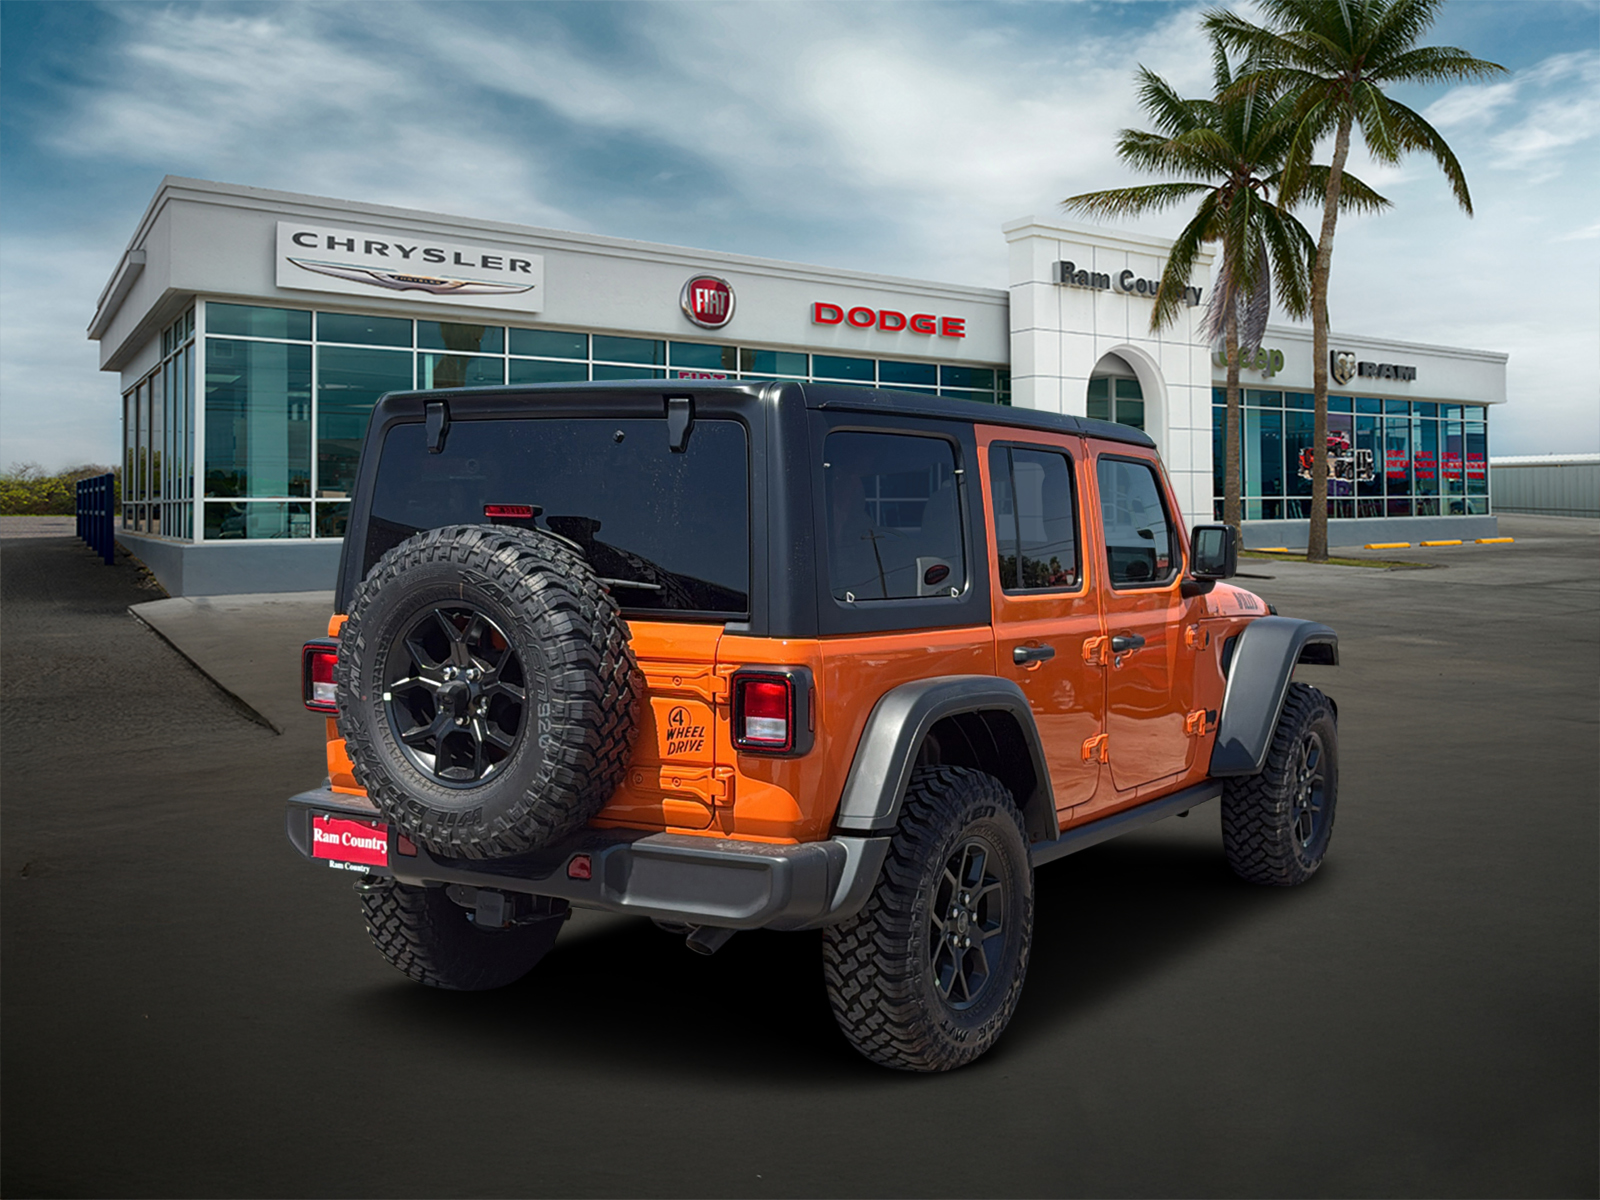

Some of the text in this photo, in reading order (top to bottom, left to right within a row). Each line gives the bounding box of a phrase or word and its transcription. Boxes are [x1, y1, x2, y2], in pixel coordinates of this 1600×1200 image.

[291, 231, 533, 274] CHRYSLER
[1052, 260, 1203, 308] Ram Coury
[695, 288, 728, 316] FIAT
[811, 301, 967, 339] DODGE
[1358, 361, 1417, 382] RAM
[672, 710, 683, 726] 4
[666, 725, 705, 742] WHEEL
[667, 740, 704, 755] DRIVE
[314, 827, 388, 854] Ram Country
[329, 859, 371, 874] Ram Country
